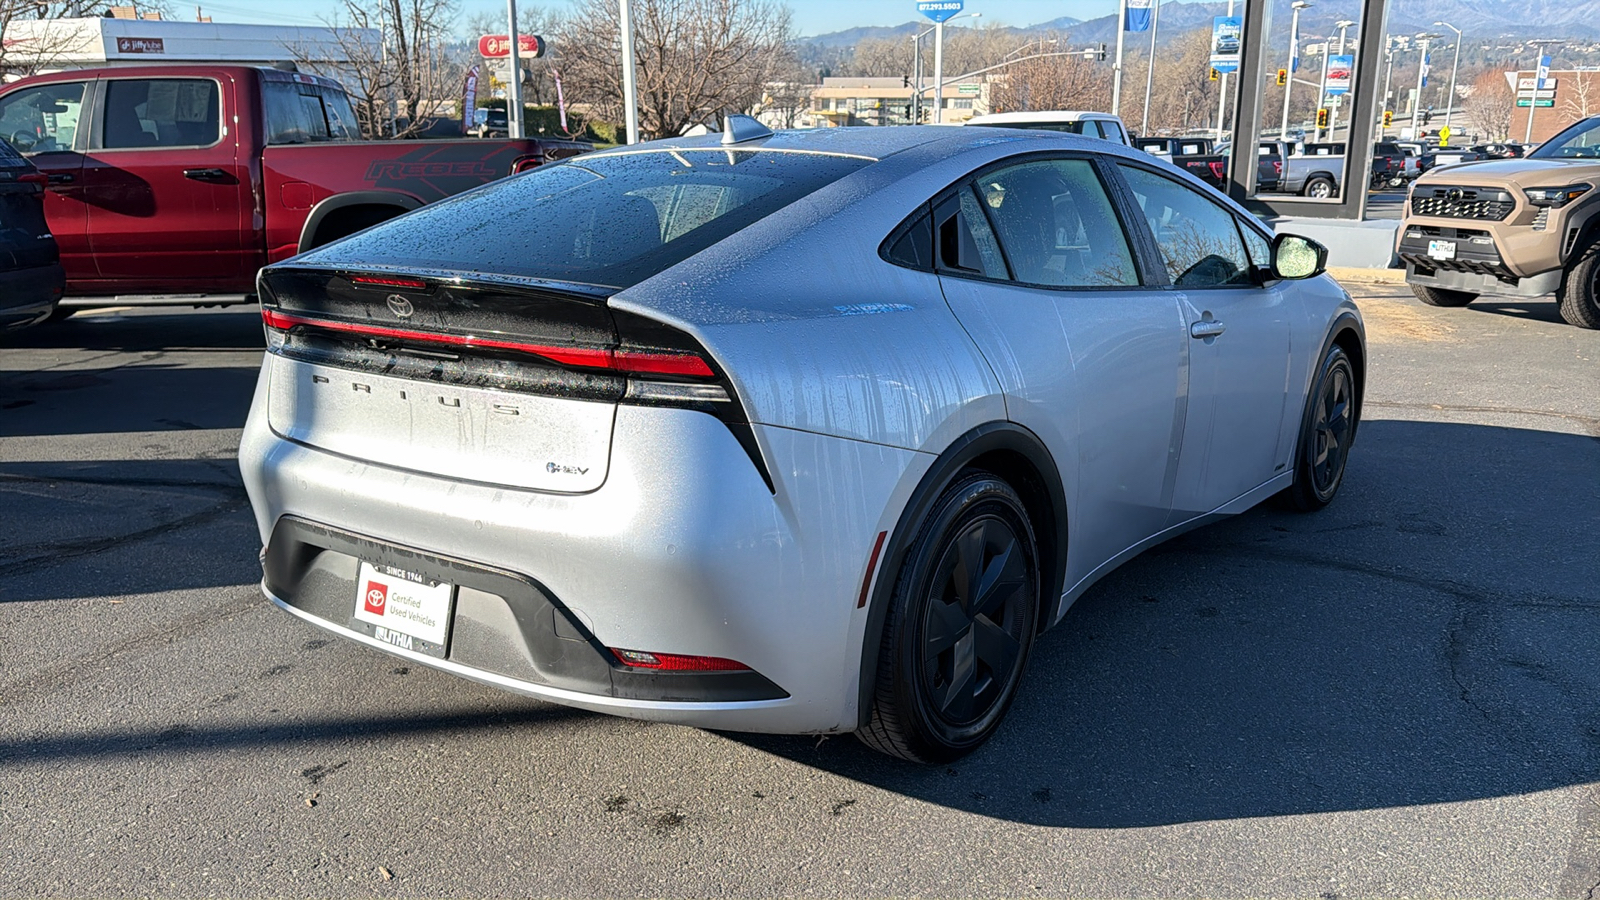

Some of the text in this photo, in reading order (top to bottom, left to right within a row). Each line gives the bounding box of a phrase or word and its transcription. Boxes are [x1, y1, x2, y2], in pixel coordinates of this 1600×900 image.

[364, 160, 496, 181] REBEL
[1435, 243, 1454, 253] LITHIA
[312, 374, 520, 415] PRIUS
[386, 565, 423, 583] SINCE 1946
[391, 592, 422, 609] Certified
[389, 604, 436, 627] Used Vehicles
[383, 627, 413, 650] LITHIA
